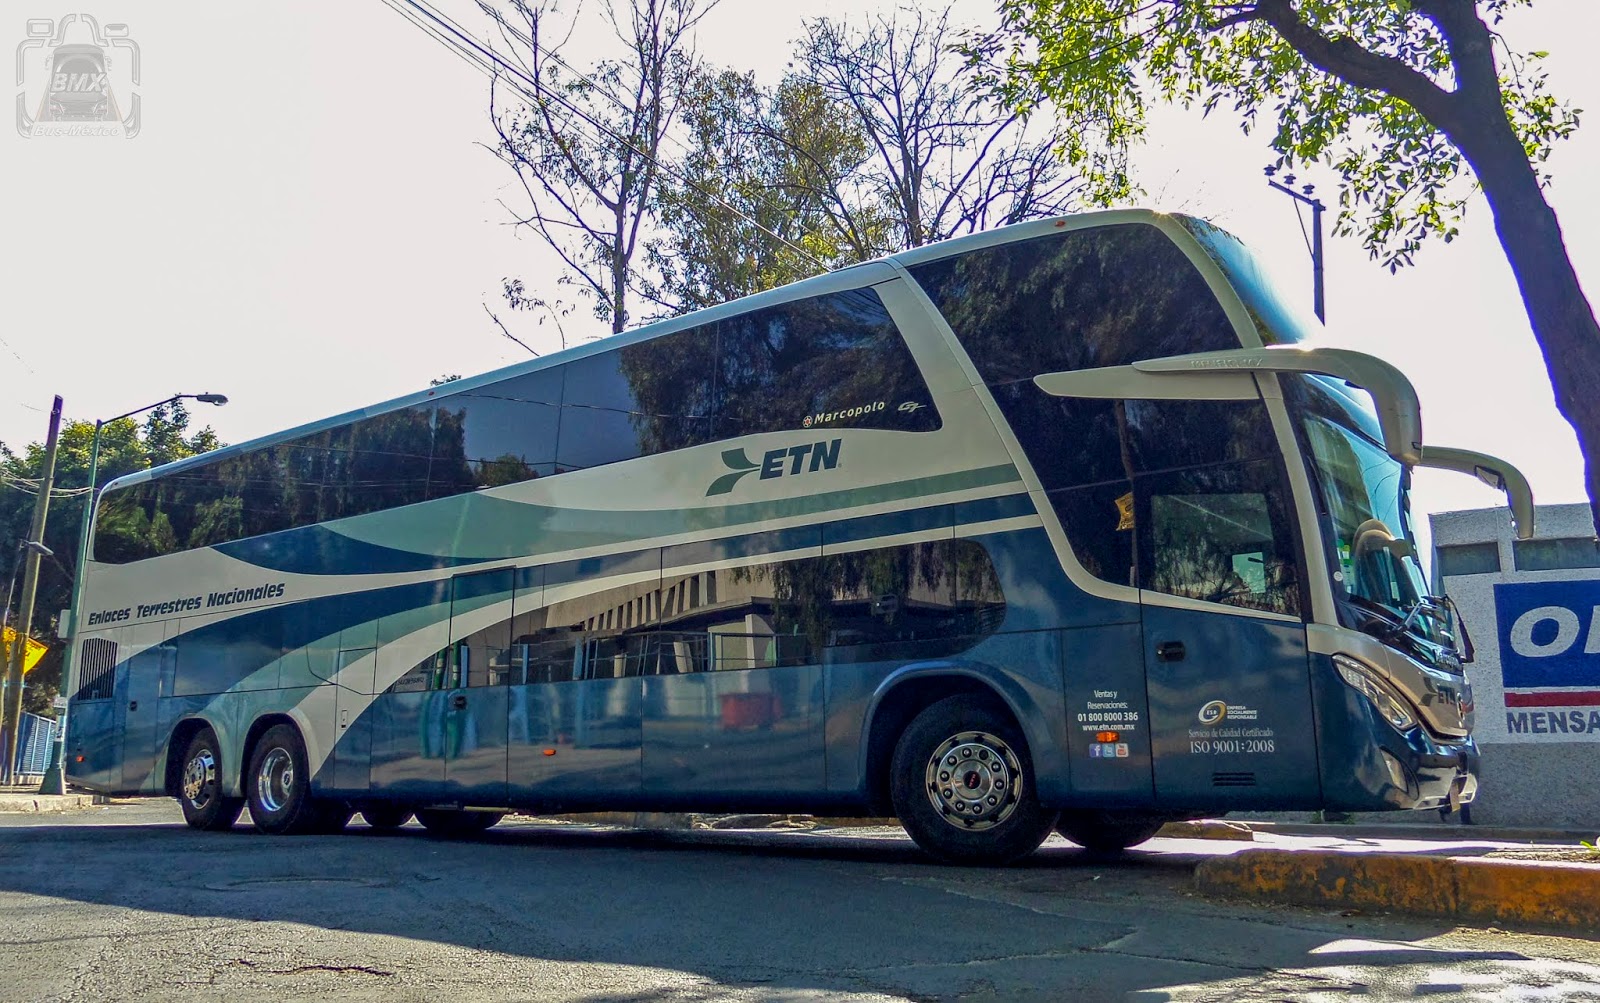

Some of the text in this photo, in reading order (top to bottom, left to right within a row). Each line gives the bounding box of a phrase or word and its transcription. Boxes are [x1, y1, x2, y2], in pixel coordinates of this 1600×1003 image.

[814, 401, 885, 425] Marcopolo
[760, 438, 842, 480] ETN
[88, 582, 285, 625] Enlaces Terrestres Nacionales
[1094, 690, 1113, 698] Ventas
[1087, 701, 1128, 710] Reservaciones:
[1078, 712, 1139, 722] 01 800 8000 386
[1188, 727, 1274, 738] Servicio de Calidad Certificado
[1190, 739, 1275, 755] ISO 9001:2008
